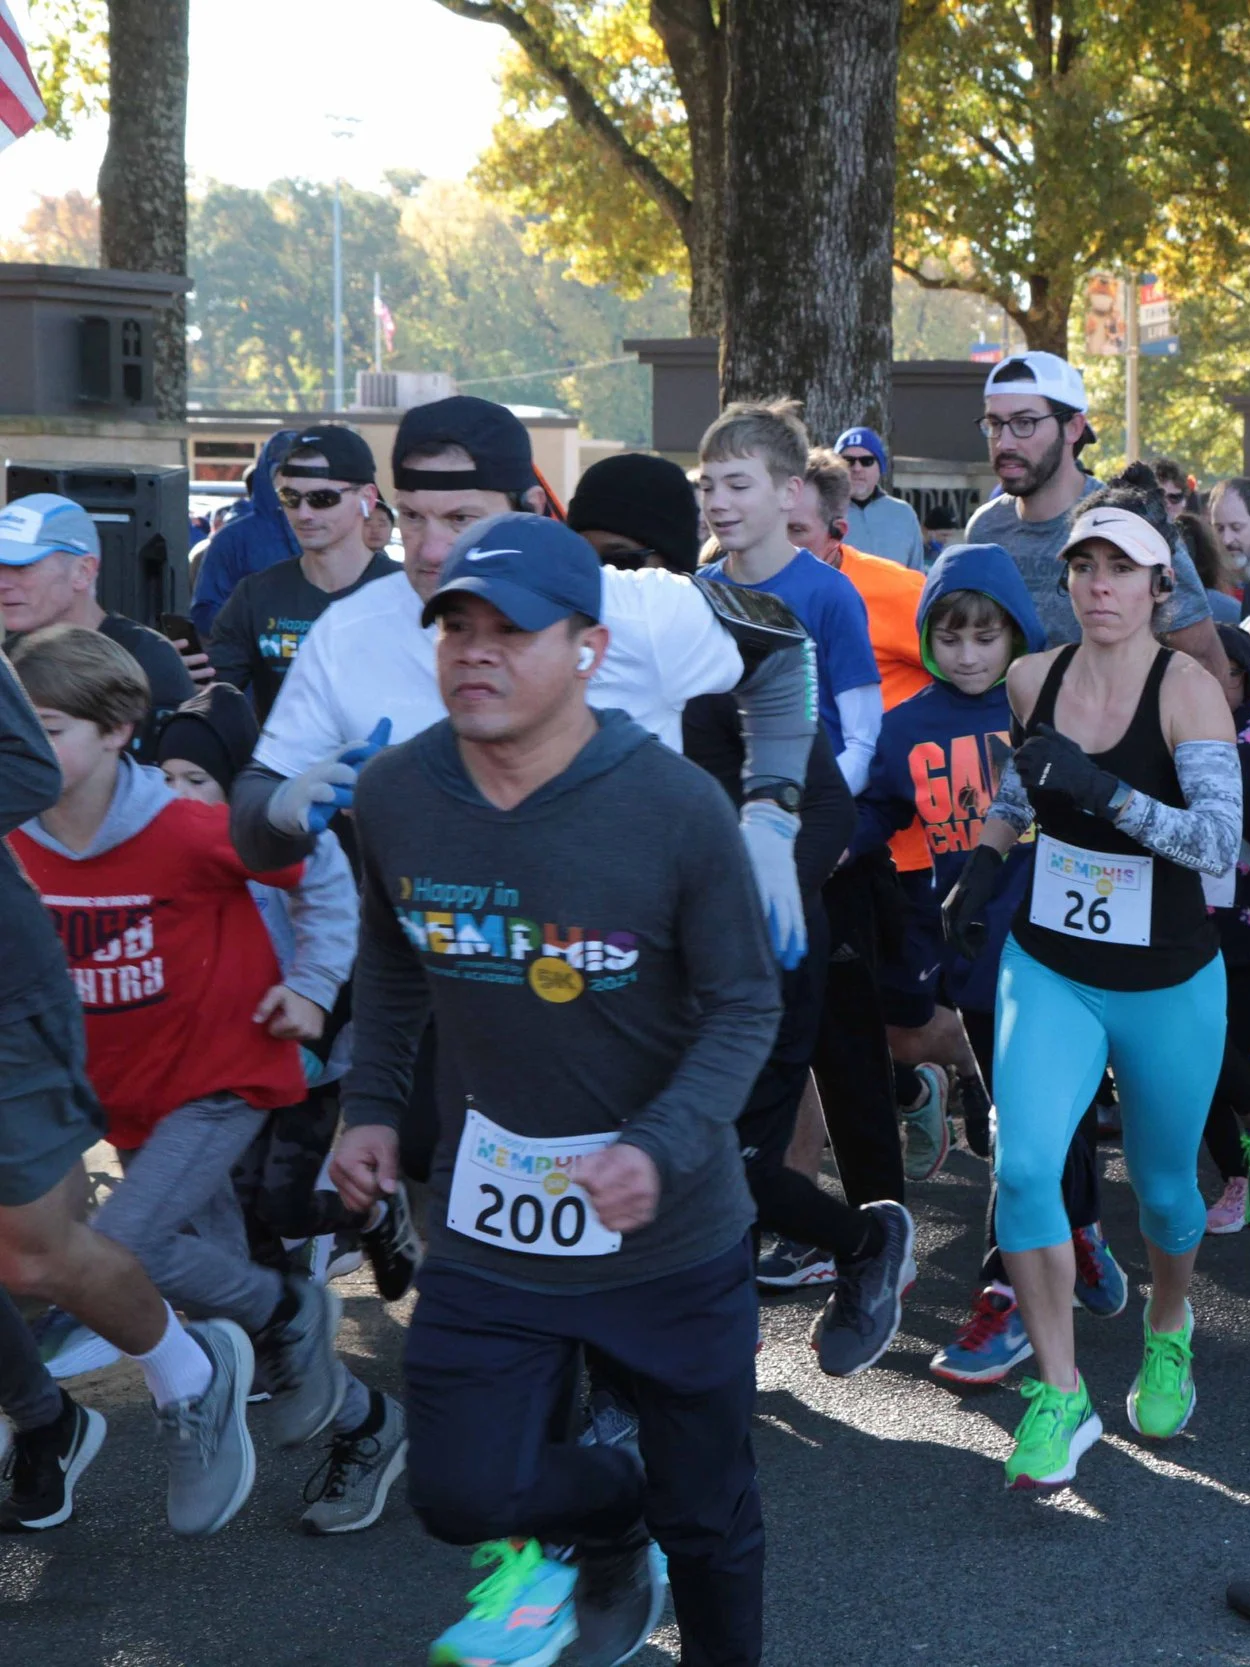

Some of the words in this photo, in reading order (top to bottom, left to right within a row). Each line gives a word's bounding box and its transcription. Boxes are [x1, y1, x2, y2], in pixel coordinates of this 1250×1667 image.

[1050, 853, 1135, 883] MEMPHIS
[1153, 836, 1223, 873] Columbia
[413, 877, 491, 910] Happy
[494, 881, 520, 907] in
[1063, 890, 1111, 935] 26
[395, 907, 640, 971] MEMPHIS
[66, 956, 165, 1004] NTRY
[474, 1183, 586, 1247] 200
